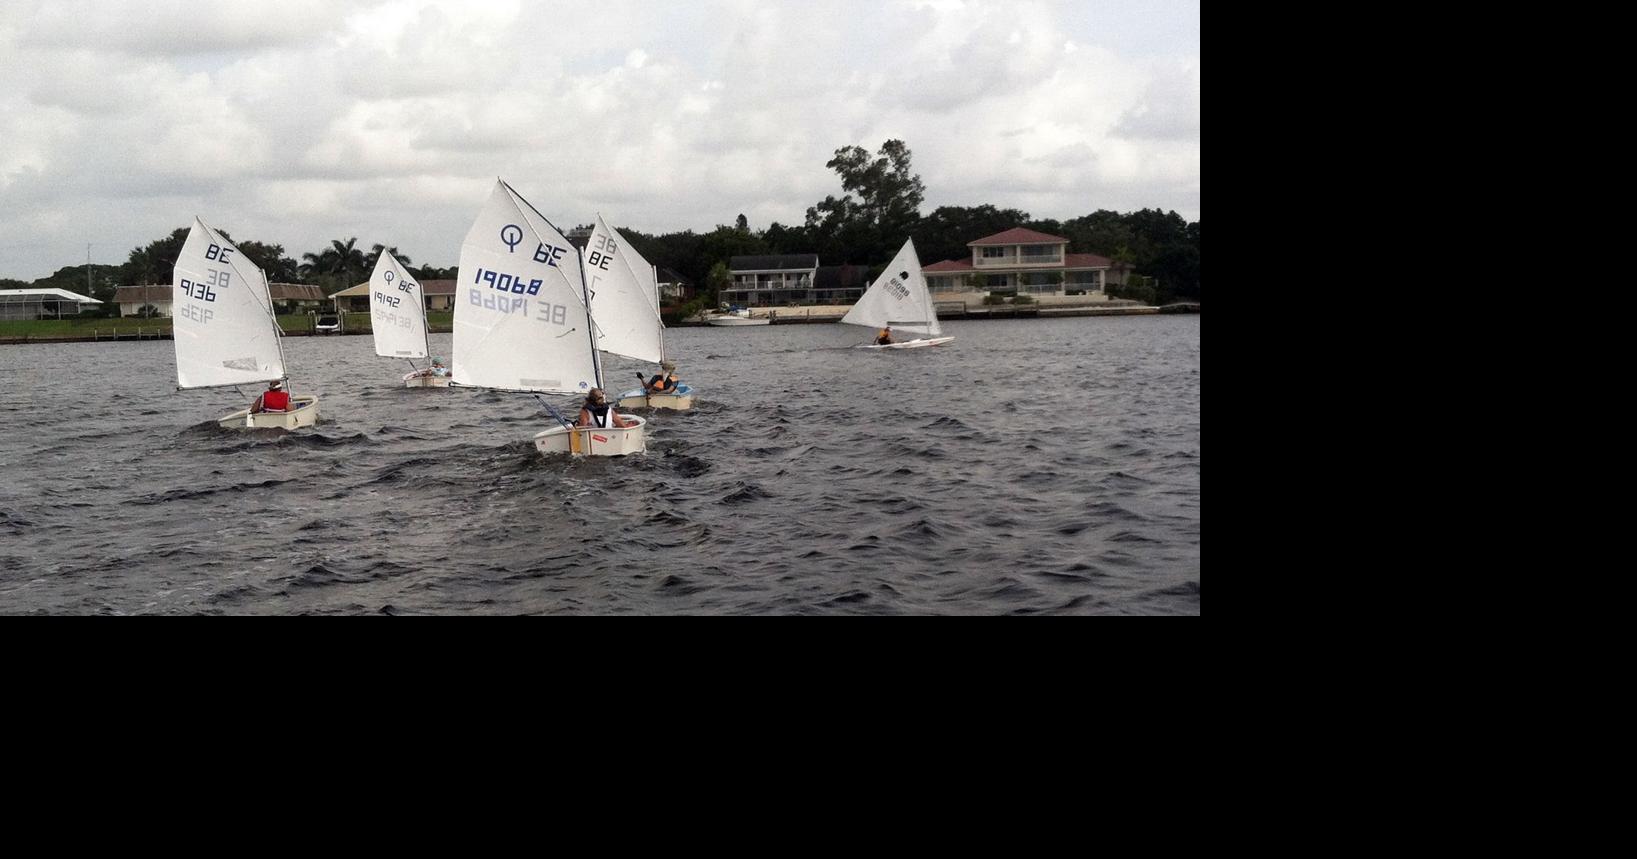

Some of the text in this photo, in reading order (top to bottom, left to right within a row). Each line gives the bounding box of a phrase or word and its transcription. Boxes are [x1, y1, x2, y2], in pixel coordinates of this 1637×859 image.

[205, 243, 234, 264] BE
[533, 242, 567, 268] BE
[588, 250, 613, 271] BE
[180, 279, 216, 302] 9136
[398, 280, 415, 294] BE
[475, 268, 543, 296] 19068
[374, 291, 400, 308] 19192
